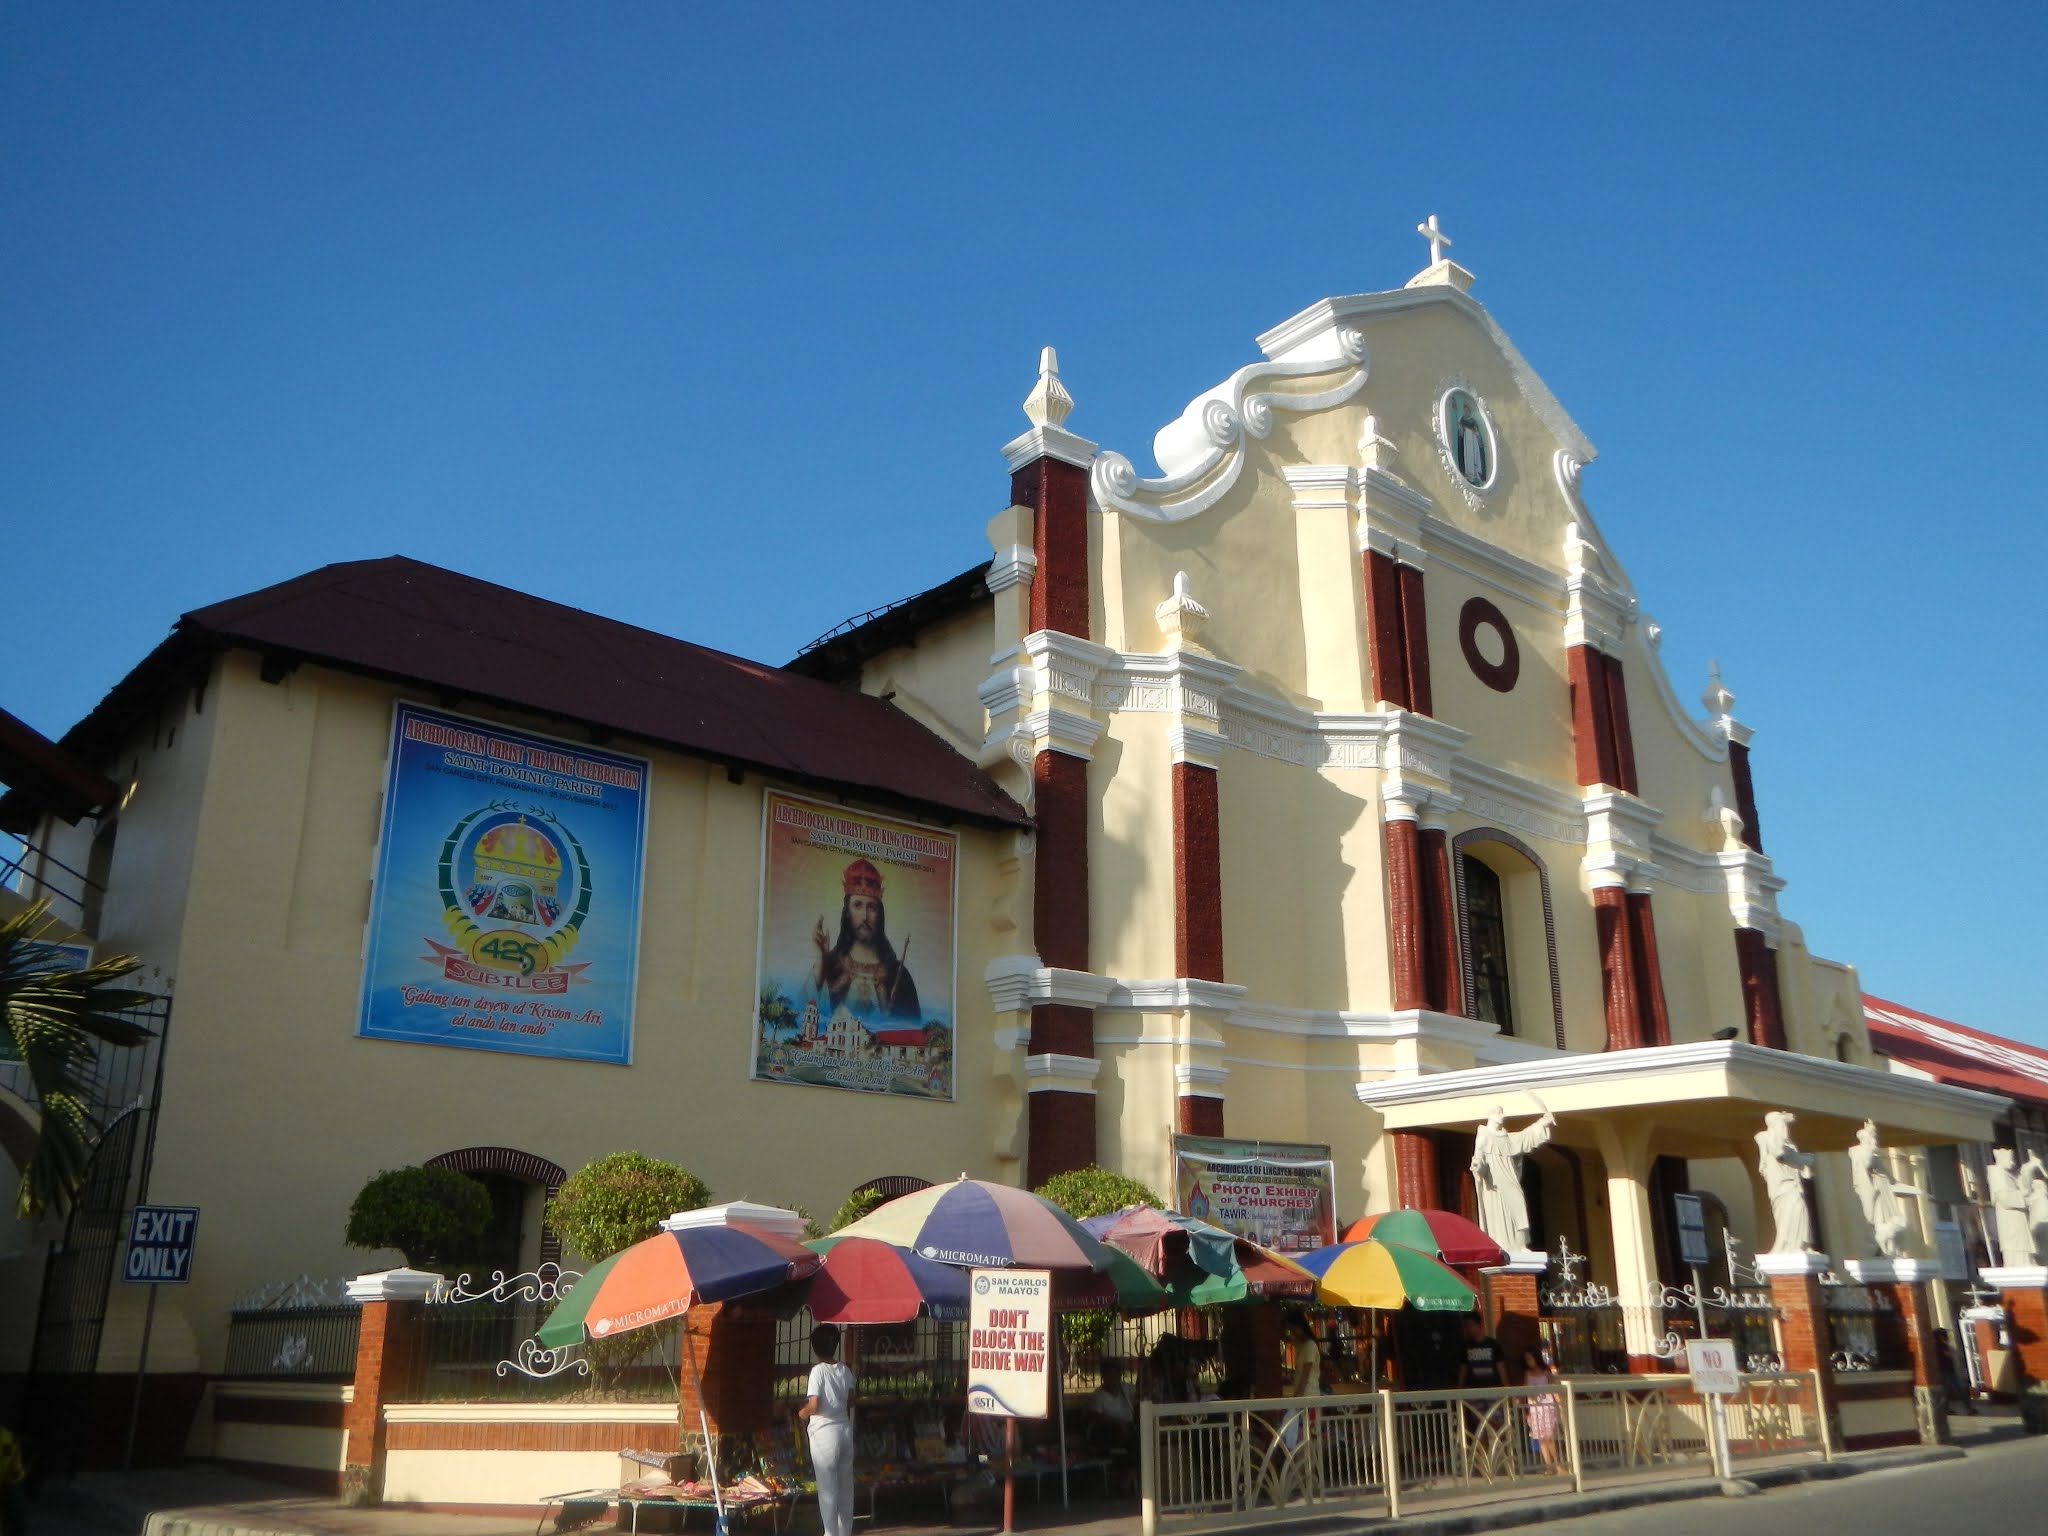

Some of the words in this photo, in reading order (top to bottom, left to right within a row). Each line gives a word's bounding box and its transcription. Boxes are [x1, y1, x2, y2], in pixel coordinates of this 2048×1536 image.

[405, 718, 486, 756] ARCHDIOCESAN
[487, 738, 525, 764] CHRIST
[527, 747, 547, 770] THE
[548, 752, 574, 776] KING
[575, 758, 639, 790] CELEBRATION
[443, 767, 475, 780] CARLOS
[445, 752, 488, 773] SAINT
[489, 762, 551, 787] DOMINIC
[555, 777, 602, 798] PARISH
[776, 803, 835, 834] ARCHDIOCESAN
[836, 818, 863, 840] CHRIST
[865, 824, 880, 843] THE
[880, 828, 901, 849] KING
[901, 832, 949, 859] CELEBRATION
[791, 836, 803, 845] SAN
[803, 840, 828, 851] CARLOS
[844, 848, 880, 862] PANGASINAN
[891, 859, 922, 870] NOVEMBER
[810, 830, 837, 845] SAINT
[840, 837, 883, 855] DOMINIC
[885, 847, 918, 862] PARISH
[479, 937, 540, 977] 425
[446, 961, 566, 991] JUBILEE
[451, 994, 471, 1008] tan
[473, 996, 510, 1014] dayew
[512, 1002, 526, 1015] ed
[527, 1002, 572, 1021] Kriston
[452, 1012, 465, 1026] ed
[467, 1015, 495, 1030] ando
[498, 1017, 517, 1032] lan
[1206, 1163, 1253, 1175] ARCHDIOCESE
[1253, 1166, 1262, 1175] OF
[1212, 1183, 1261, 1196] PHOTO
[1265, 1185, 1319, 1198] EXHIBIT
[1237, 1195, 1312, 1208] CHURCHES
[134, 1211, 193, 1243] EXIT
[128, 1247, 189, 1277] ONLY
[938, 1250, 1008, 1266] MICROMATIC
[991, 1277, 1009, 1286] SAN
[1012, 1278, 1047, 1287] CARLOS
[999, 1287, 1039, 1296] MAAYOS
[611, 1297, 689, 1329] MICROMATIC
[989, 1308, 1029, 1329] DON'T
[972, 1329, 1017, 1350] BLOCK
[1019, 1331, 1045, 1351] THE
[971, 1351, 1012, 1371] DRIVE
[1014, 1352, 1046, 1373] WAY
[1702, 1350, 1722, 1369] NO
[980, 1397, 995, 1409] STI
